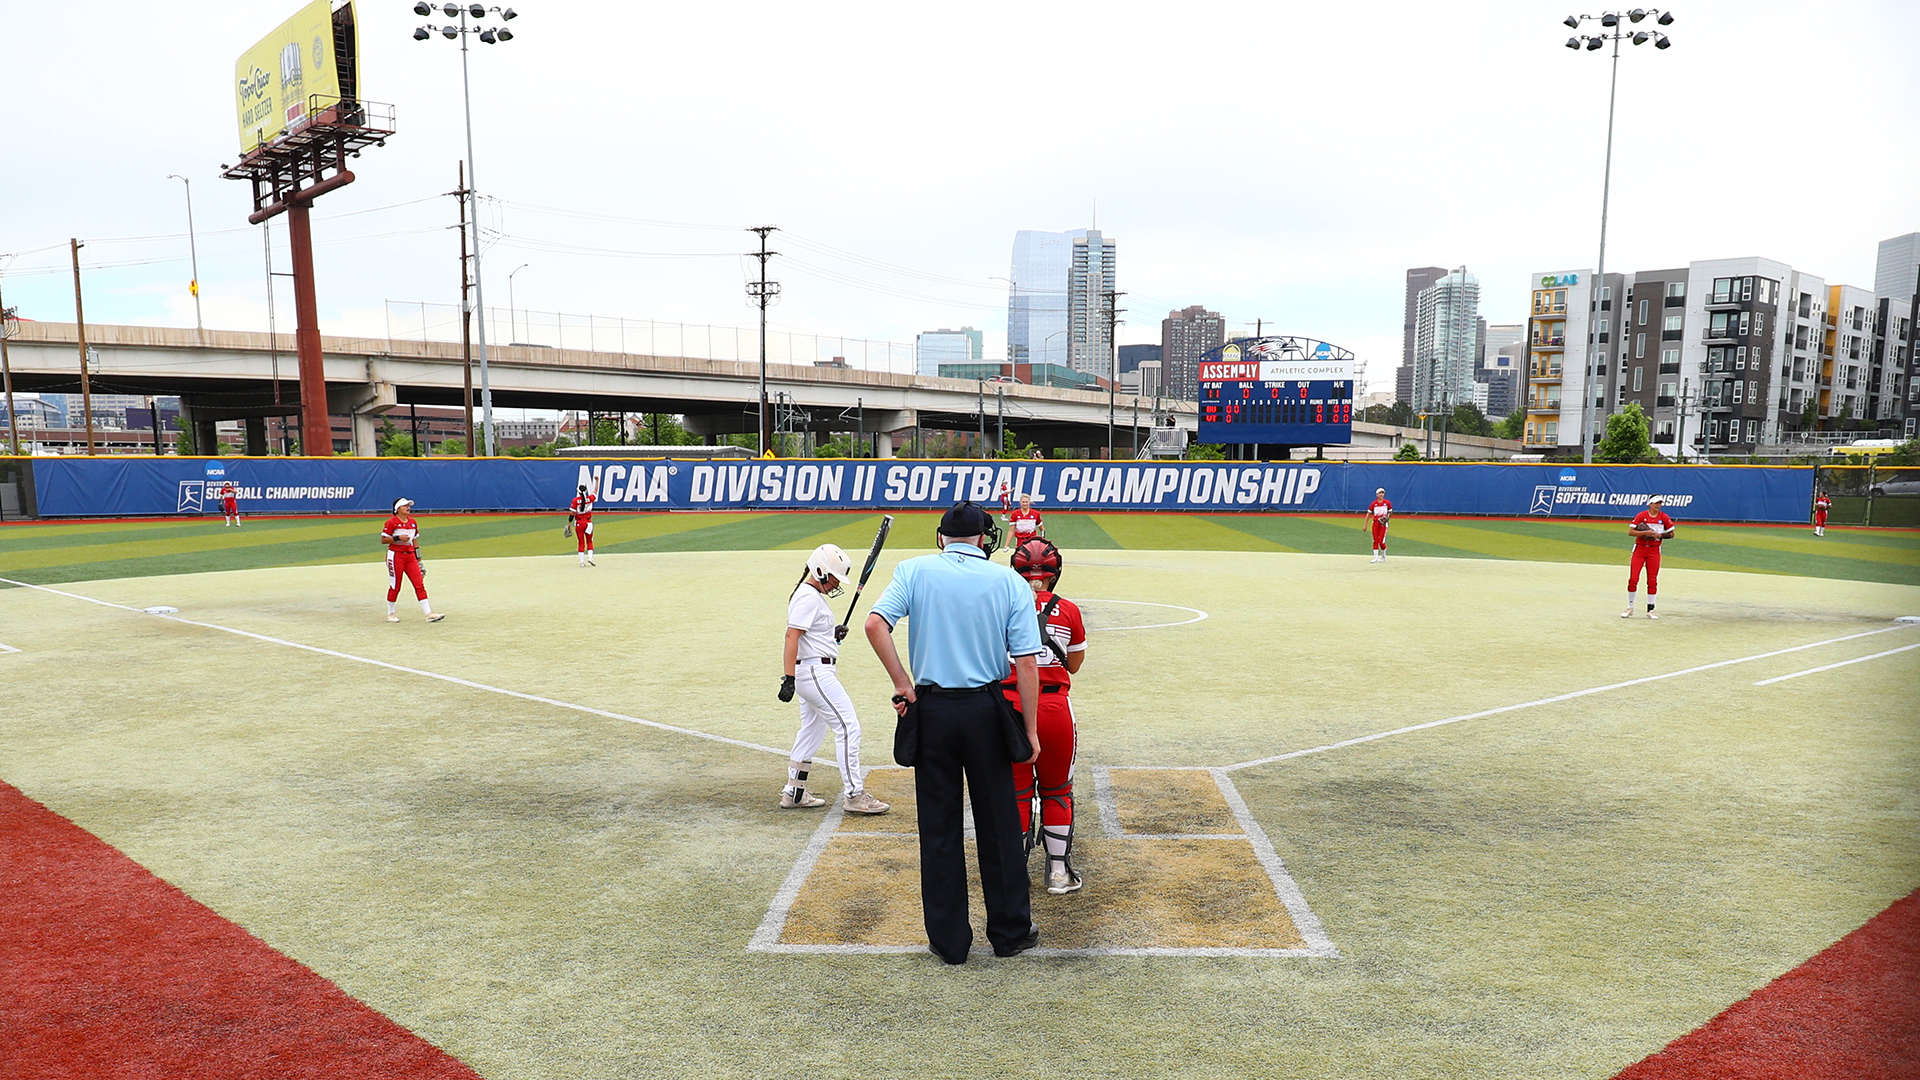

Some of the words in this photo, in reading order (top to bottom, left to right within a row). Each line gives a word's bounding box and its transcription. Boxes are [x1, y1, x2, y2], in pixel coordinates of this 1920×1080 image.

[242, 109, 254, 128] HARD
[254, 97, 273, 121] SELTZER
[1203, 364, 1258, 379] ASSEMBLY
[1307, 366, 1344, 374] COMPLEX
[1243, 388, 1250, 399] 0
[1271, 388, 1278, 399] 0
[1300, 388, 1308, 398] 0
[1226, 405, 1232, 414] 0
[1234, 405, 1240, 414] 0
[1316, 404, 1323, 413] 0
[1333, 404, 1340, 413] 0
[1343, 404, 1350, 413] 0
[1226, 414, 1232, 423] 0
[1316, 414, 1322, 423] 0
[1333, 414, 1339, 423] 0
[1343, 414, 1349, 423] 0
[690, 466, 844, 502] DIVISION
[852, 466, 876, 501] II
[884, 466, 1046, 502] SOFTBALL
[1056, 467, 1321, 504] CHAMPIONSHIP
[206, 487, 263, 500] SOBALL
[266, 487, 355, 499] CHAMPIONSHIP
[1555, 492, 1606, 504] SOFTBALL
